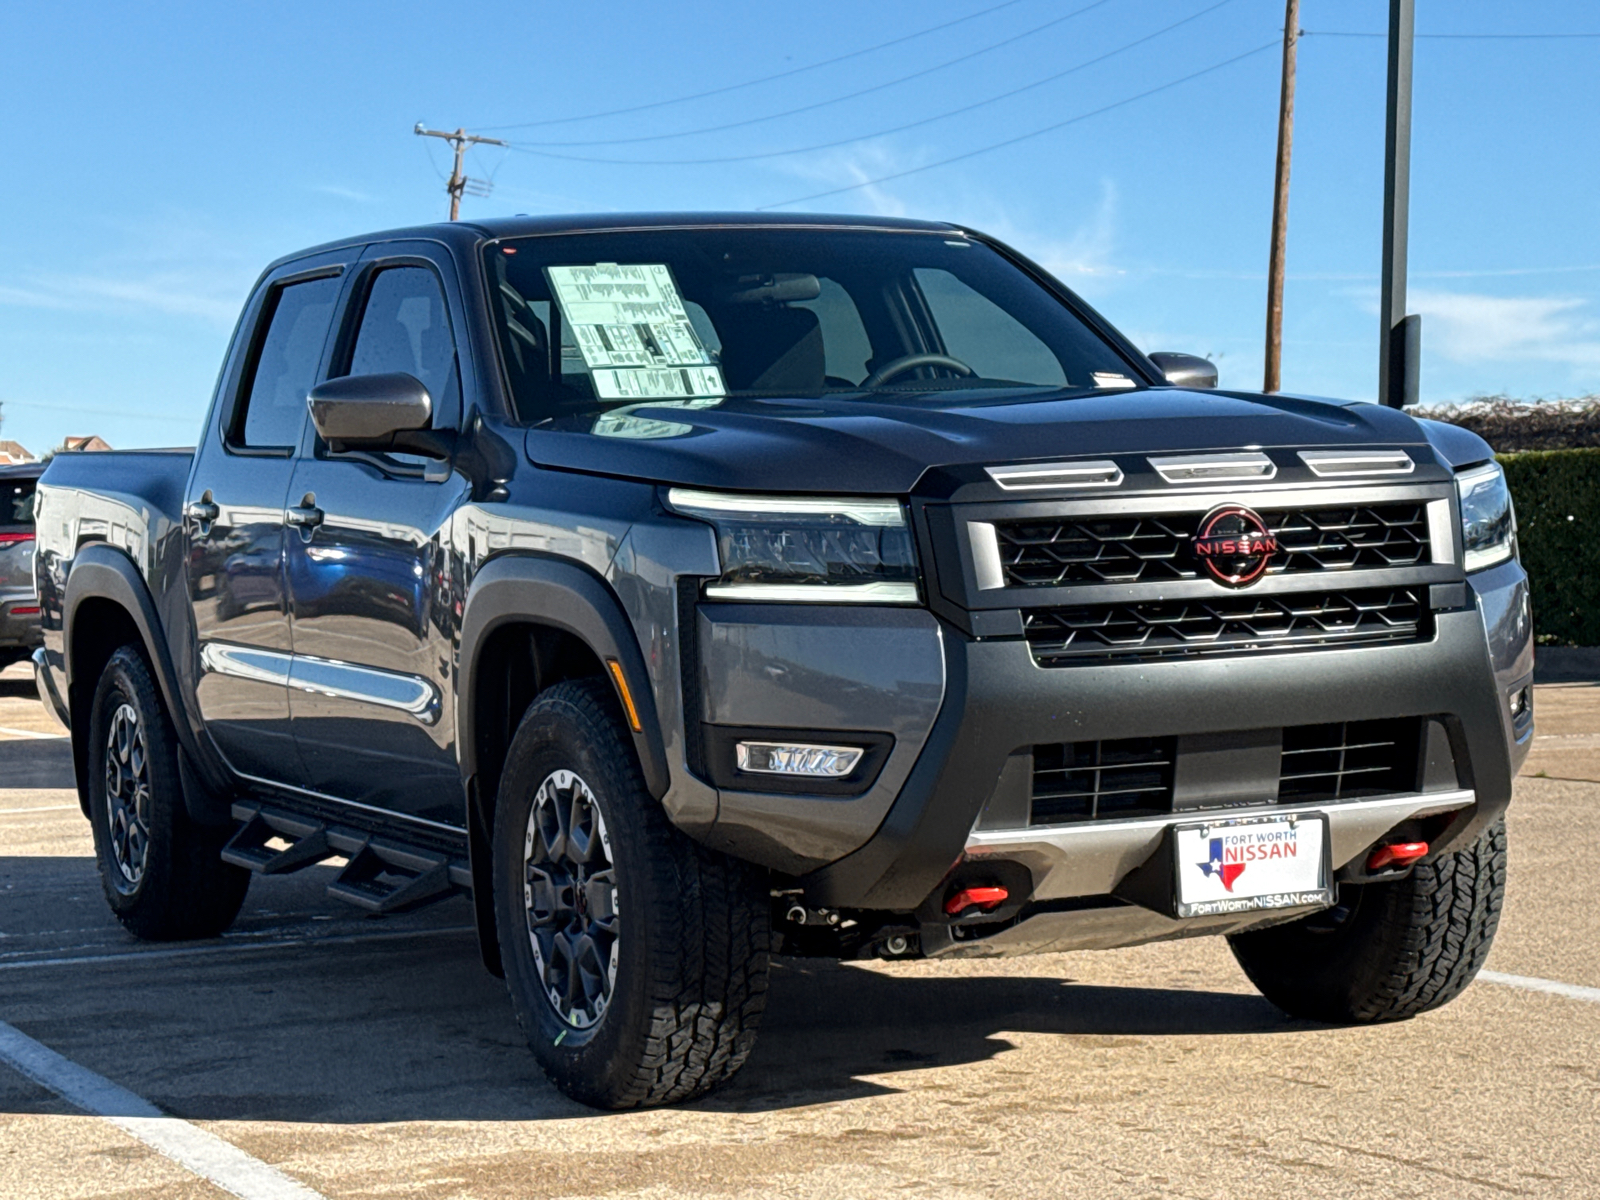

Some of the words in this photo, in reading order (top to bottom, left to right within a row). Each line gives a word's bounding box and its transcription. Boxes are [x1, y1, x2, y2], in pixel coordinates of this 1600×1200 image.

[1196, 539, 1276, 555] NISSAN
[1225, 834, 1254, 845] FORT
[1256, 831, 1297, 843] WORTH
[1225, 841, 1297, 862] NISSAN
